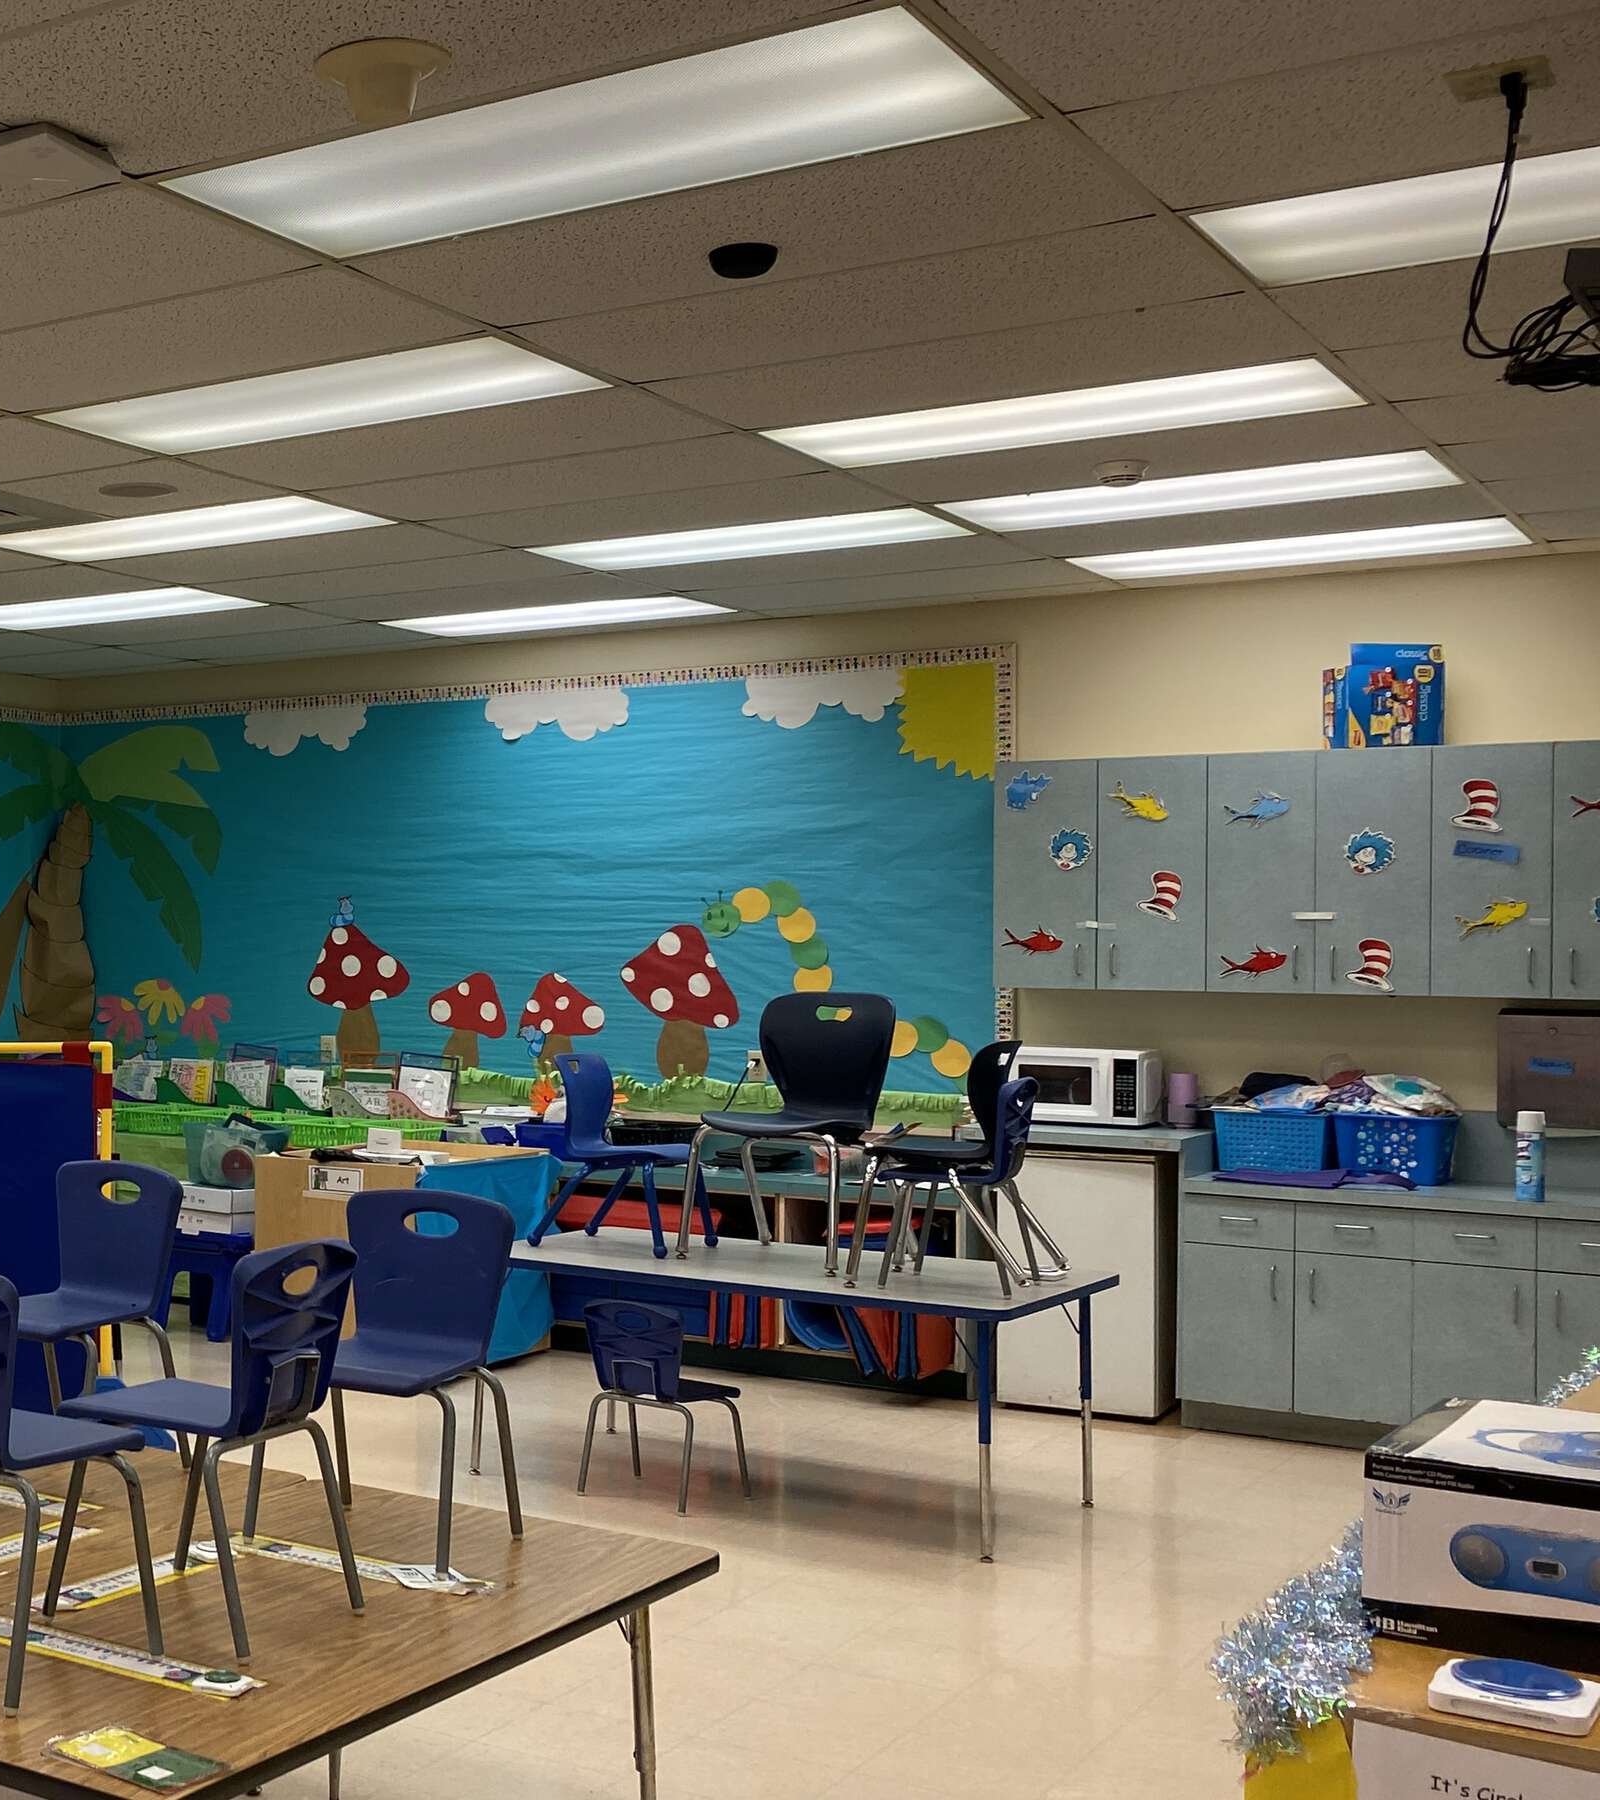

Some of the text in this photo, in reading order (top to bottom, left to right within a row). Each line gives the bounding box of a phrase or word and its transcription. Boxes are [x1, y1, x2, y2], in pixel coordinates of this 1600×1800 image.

[336, 1176, 350, 1185] Art
[1437, 1471, 1455, 1480] Player
[1396, 1619, 1438, 1633] Hamilton
[1430, 1774, 1471, 1798] It's
